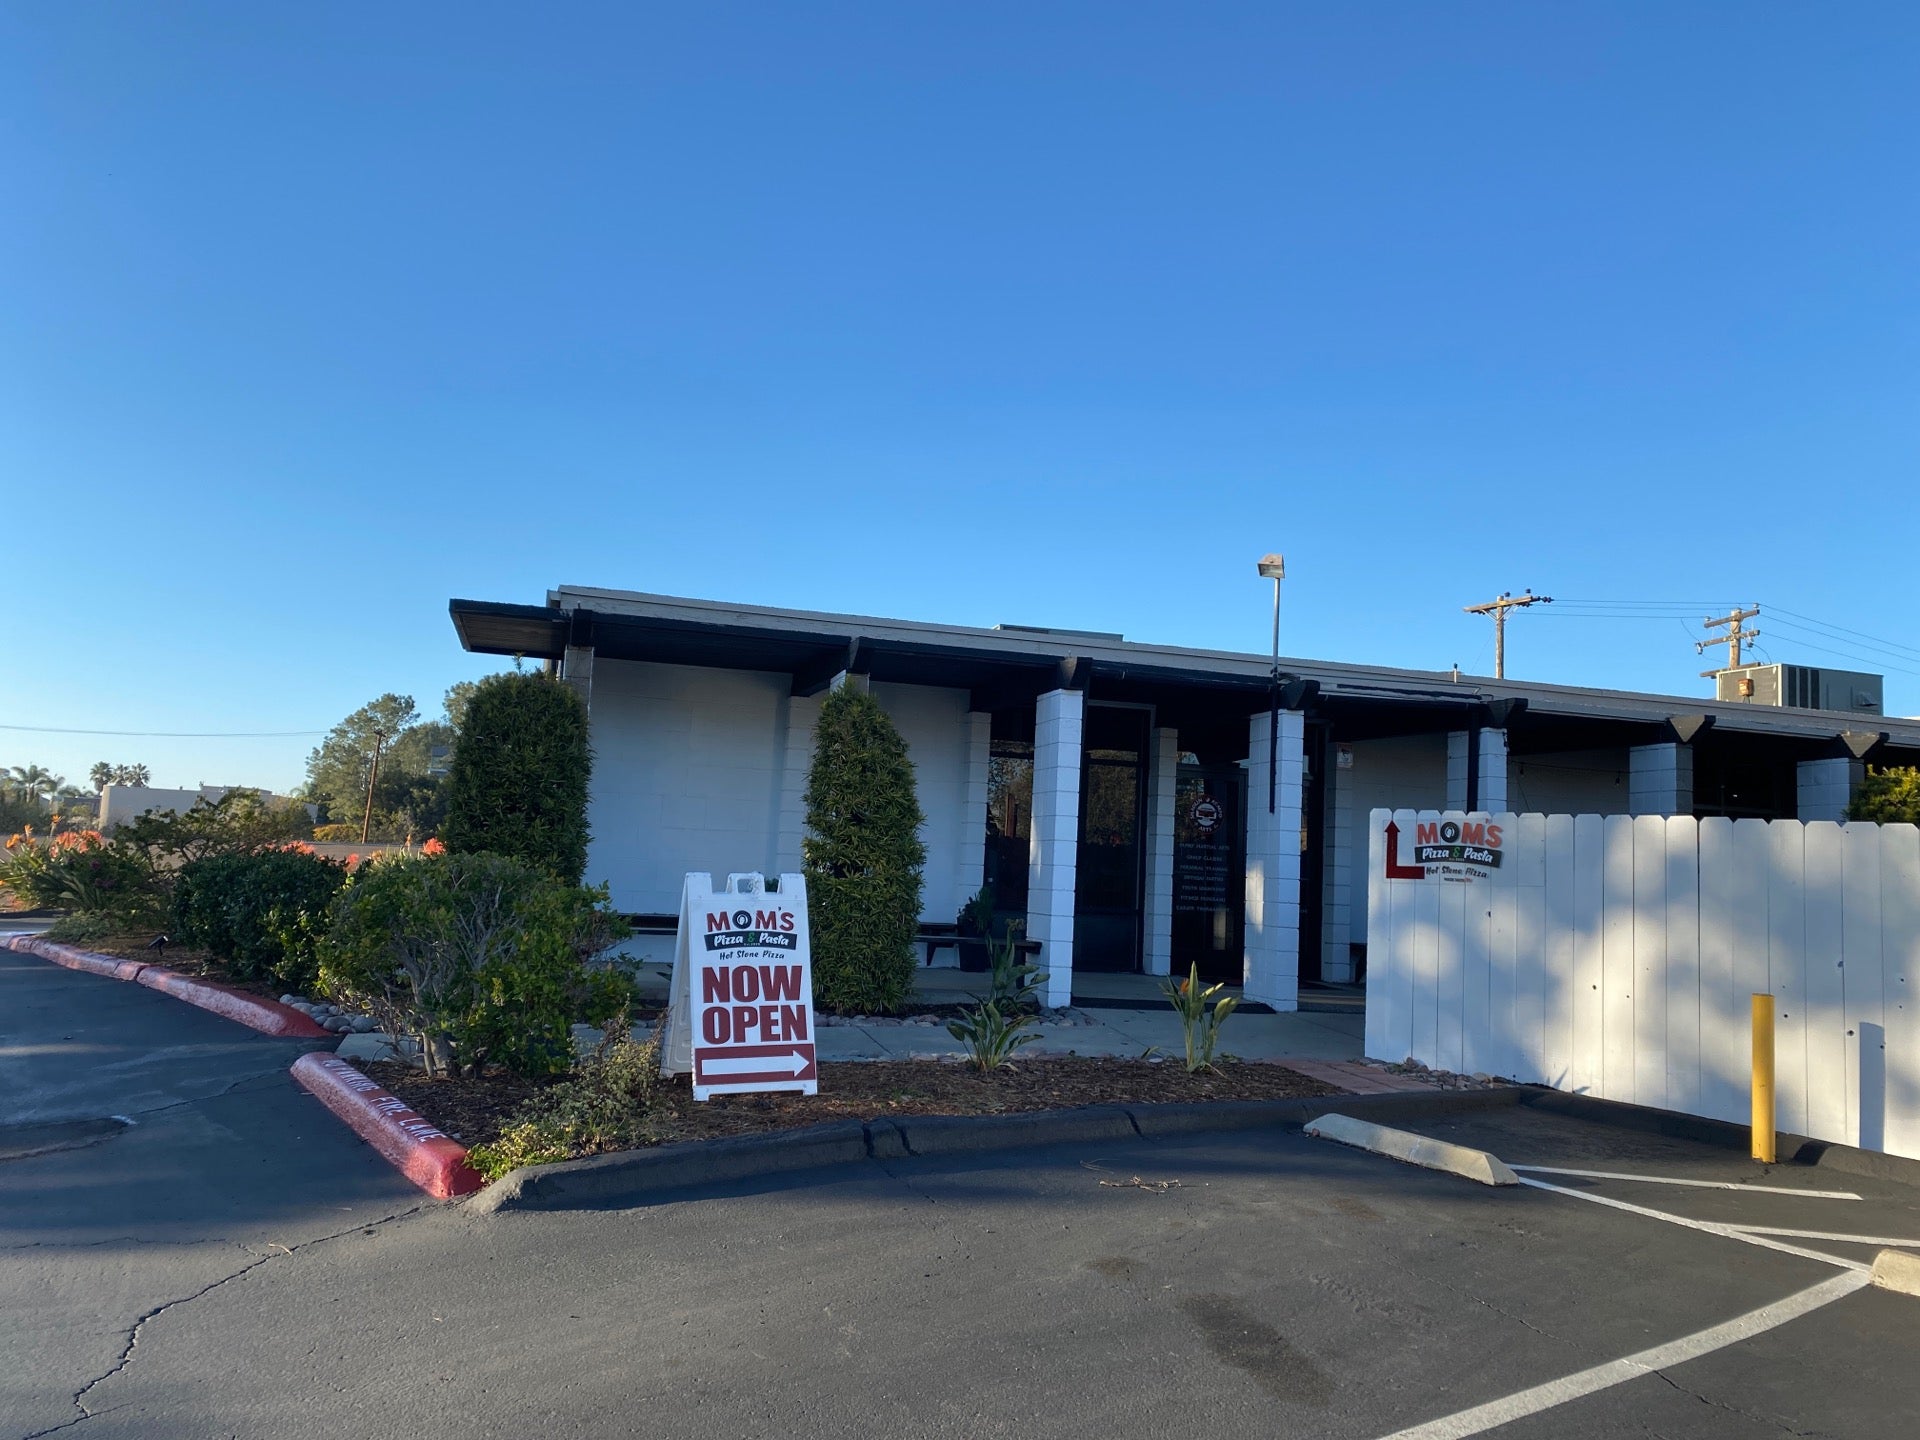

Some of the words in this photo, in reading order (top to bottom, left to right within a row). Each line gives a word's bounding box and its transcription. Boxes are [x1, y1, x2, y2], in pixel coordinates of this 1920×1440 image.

[1417, 818, 1502, 848] MOM'S
[1422, 847, 1449, 860] Pizza
[1452, 846, 1460, 858] &
[1464, 847, 1493, 863] Pasta
[1426, 866, 1439, 875] Hot
[1465, 867, 1488, 878] Pizza
[706, 906, 795, 932] MOM'S
[714, 934, 743, 947] Pizza
[747, 932, 756, 943] &
[759, 932, 789, 946] Pasta
[720, 951, 733, 960] Hot
[737, 950, 758, 959] Stone
[763, 950, 785, 959] Pizza
[702, 965, 802, 1003] NOW
[702, 1004, 808, 1044] OPEN
[371, 1096, 414, 1117] FIRE
[399, 1117, 448, 1143] LANE
